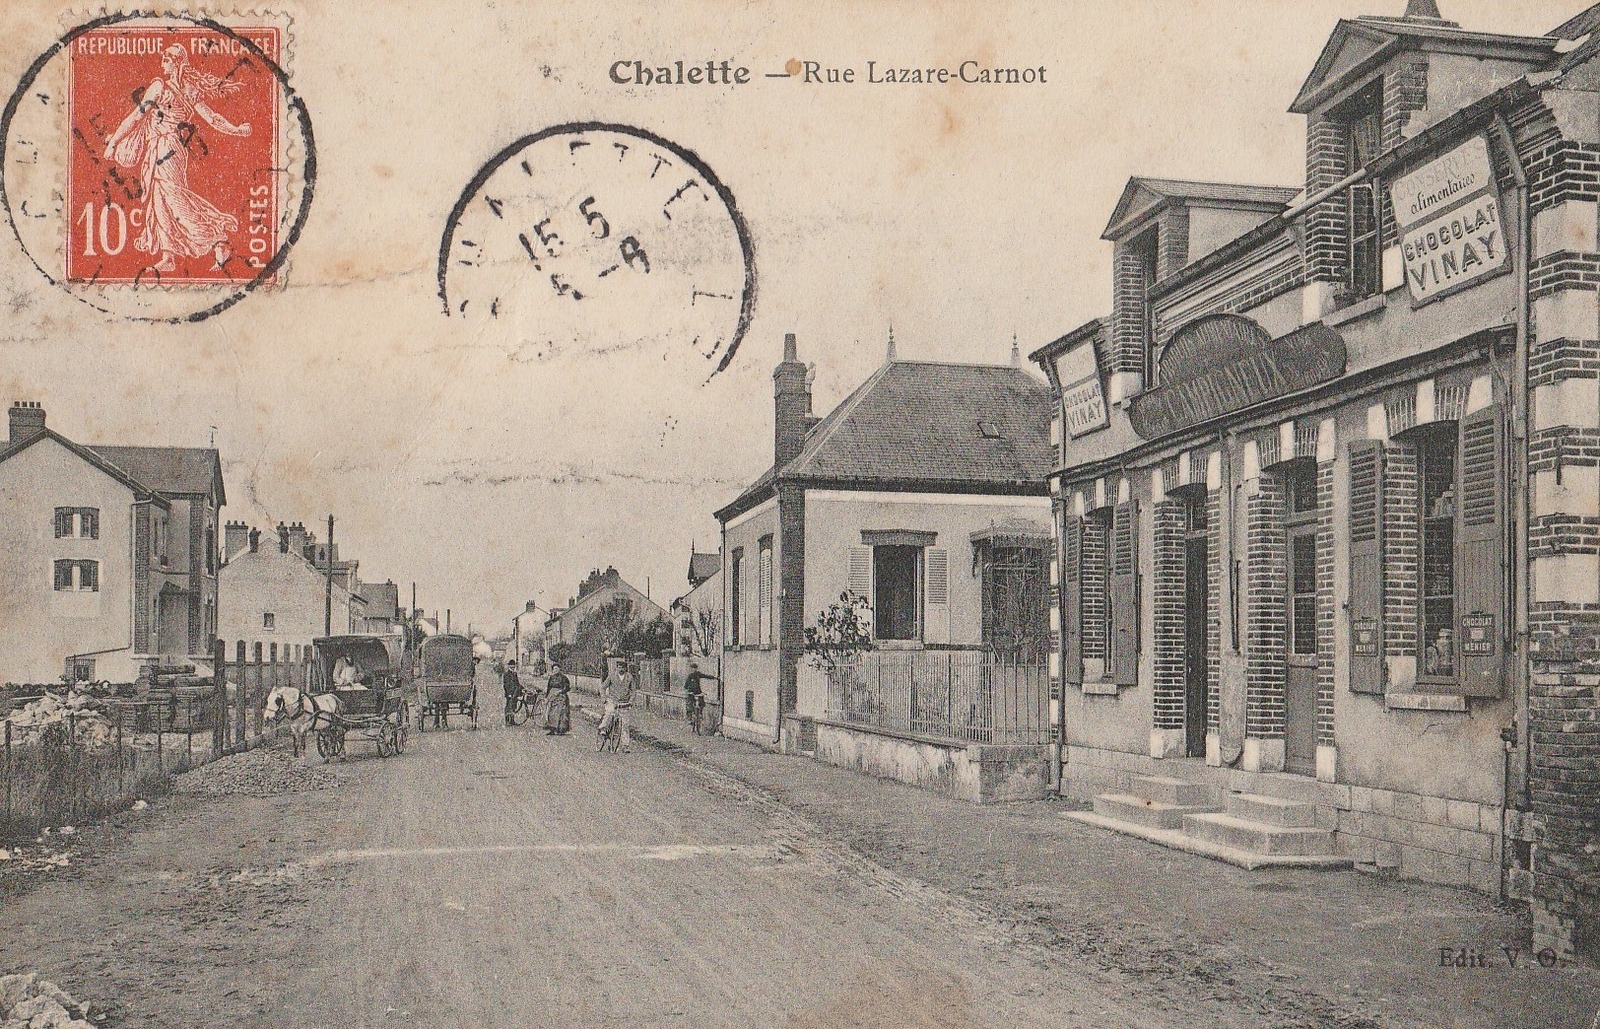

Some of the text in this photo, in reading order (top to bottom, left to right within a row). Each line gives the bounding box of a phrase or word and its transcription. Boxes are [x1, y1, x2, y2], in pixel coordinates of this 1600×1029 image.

[249, 185, 269, 269] POSTES
[1404, 203, 1496, 262] CHOCOLAT
[1409, 229, 1499, 291] VINAY
[1066, 400, 1101, 428] VINAY
[1462, 616, 1493, 627] CHOCOLAT
[1464, 642, 1492, 651] MENIER
